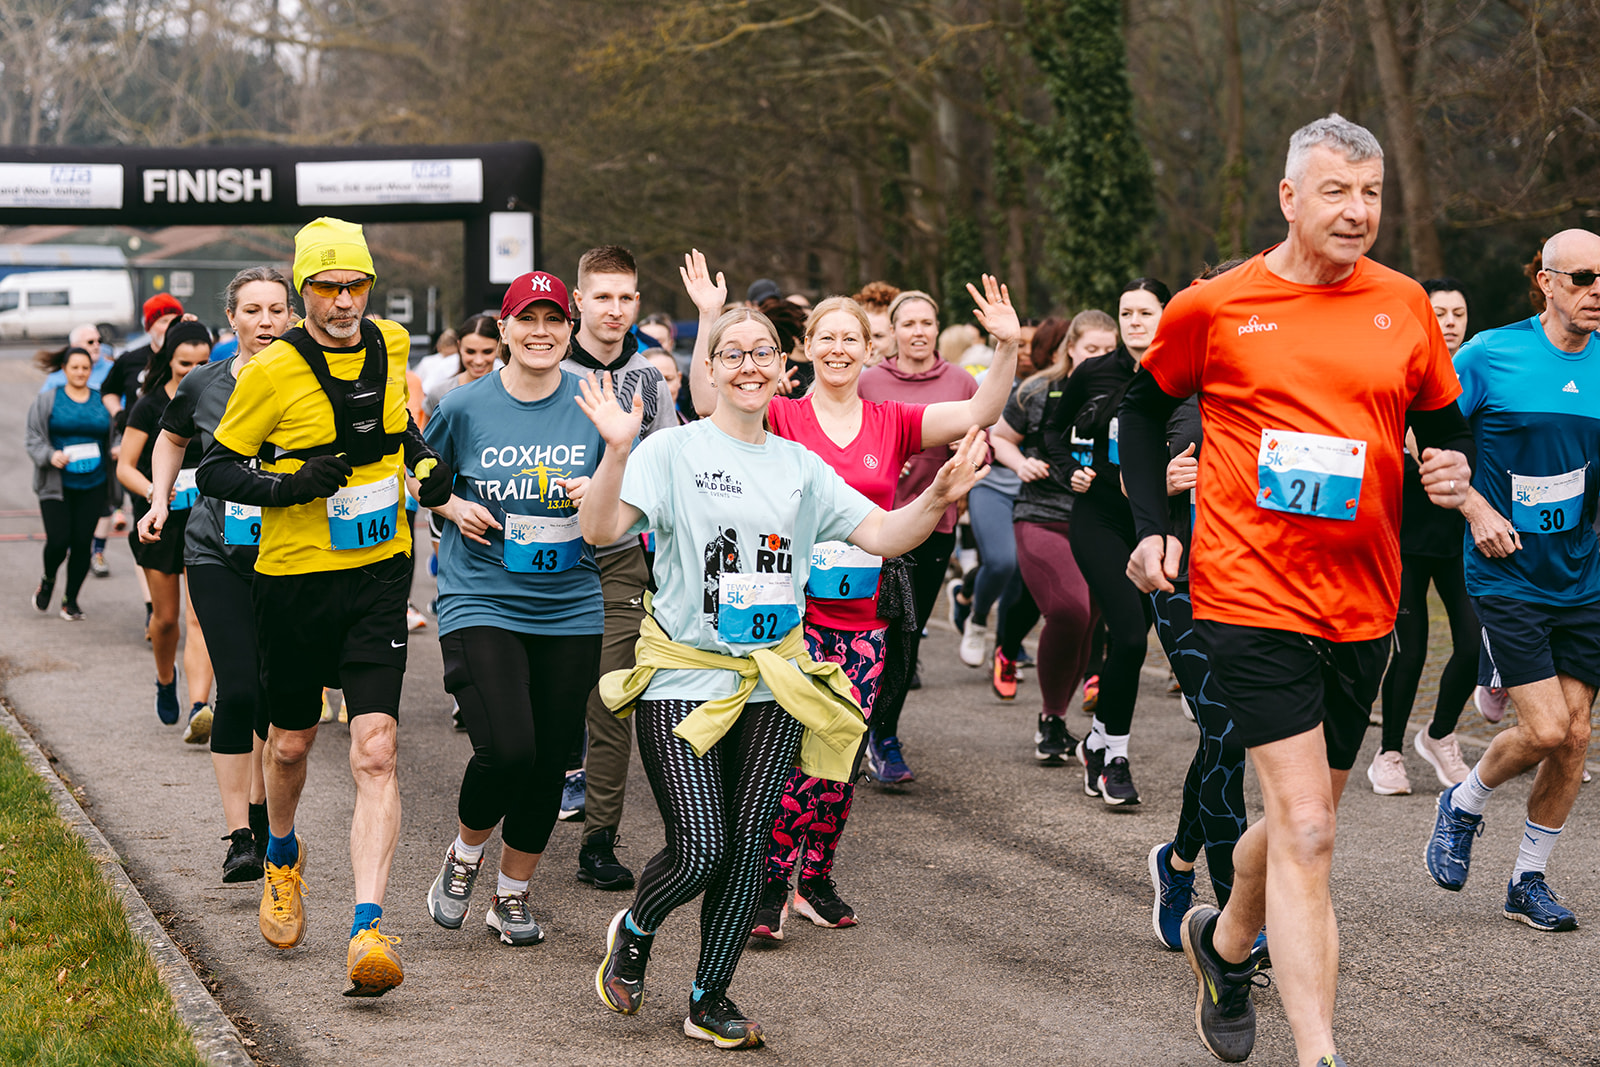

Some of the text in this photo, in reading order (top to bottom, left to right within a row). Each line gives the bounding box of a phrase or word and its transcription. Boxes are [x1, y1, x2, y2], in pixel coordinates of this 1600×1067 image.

[143, 168, 272, 203] FINISH
[531, 275, 552, 292] NY
[1238, 315, 1278, 336] parkrun
[481, 444, 586, 468] COXHOE
[1265, 452, 1283, 466] 5k
[475, 478, 540, 501] TRAIL
[695, 480, 743, 494] WILD DEER
[1515, 484, 1536, 492] TEWV
[331, 497, 354, 505] TEWV
[710, 491, 731, 499] EVENTS
[1288, 479, 1321, 512] 21
[1516, 491, 1531, 502] 5k
[231, 506, 244, 516] 5k
[333, 505, 350, 516] 5k
[510, 522, 531, 531] TEWV
[1540, 508, 1565, 531] 30
[357, 515, 390, 546] 146
[510, 530, 526, 540] 5k
[531, 549, 558, 571] 43
[756, 549, 792, 573] RU
[811, 555, 827, 566] 5k
[726, 583, 750, 592] TEWV
[838, 574, 850, 597] 6
[727, 591, 744, 604] 5k
[751, 613, 778, 640] 82
